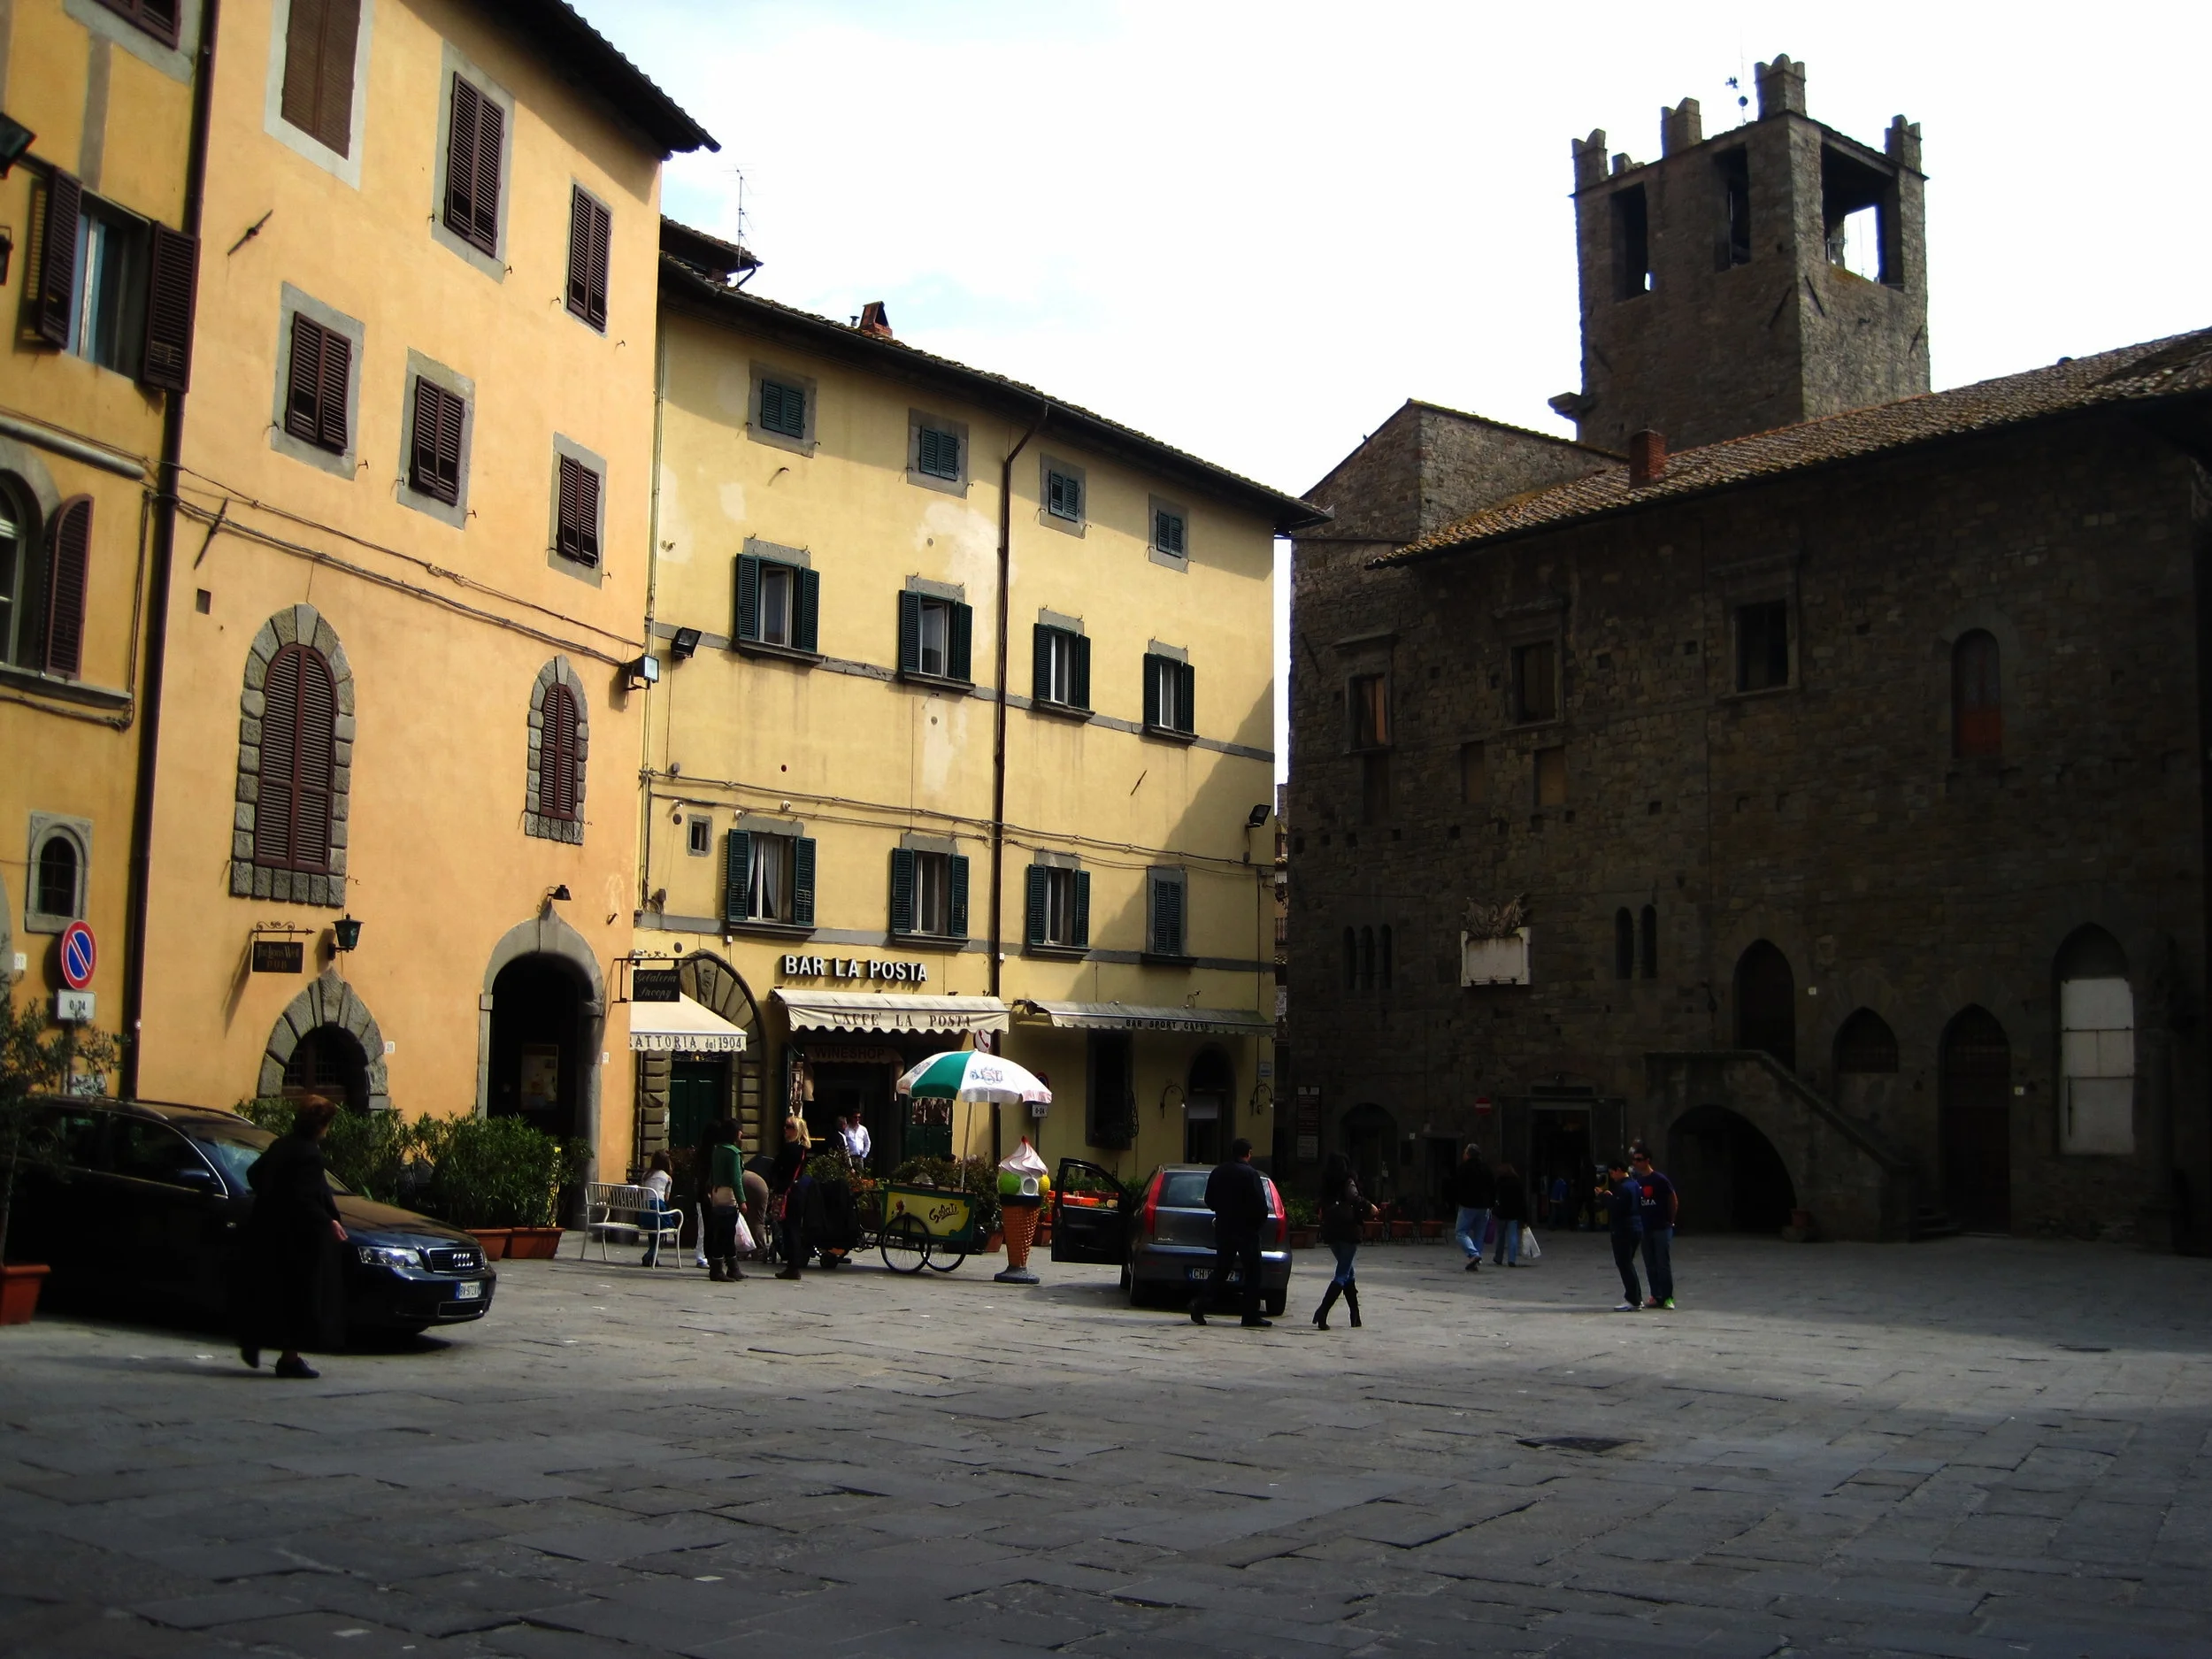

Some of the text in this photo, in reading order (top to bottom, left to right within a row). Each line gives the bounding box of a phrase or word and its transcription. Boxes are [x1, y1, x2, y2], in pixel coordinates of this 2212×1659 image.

[785, 955, 928, 981] BAR LA POSTA
[634, 972, 677, 984] Gelateria
[895, 1014, 913, 1027] LA
[930, 1014, 972, 1027] POSTA
[1125, 1018, 1142, 1028] BAR
[1149, 1019, 1177, 1029] SPORT
[705, 1038, 716, 1049] dal
[718, 1036, 741, 1049] 1904
[815, 1046, 885, 1060] WINESHOP
